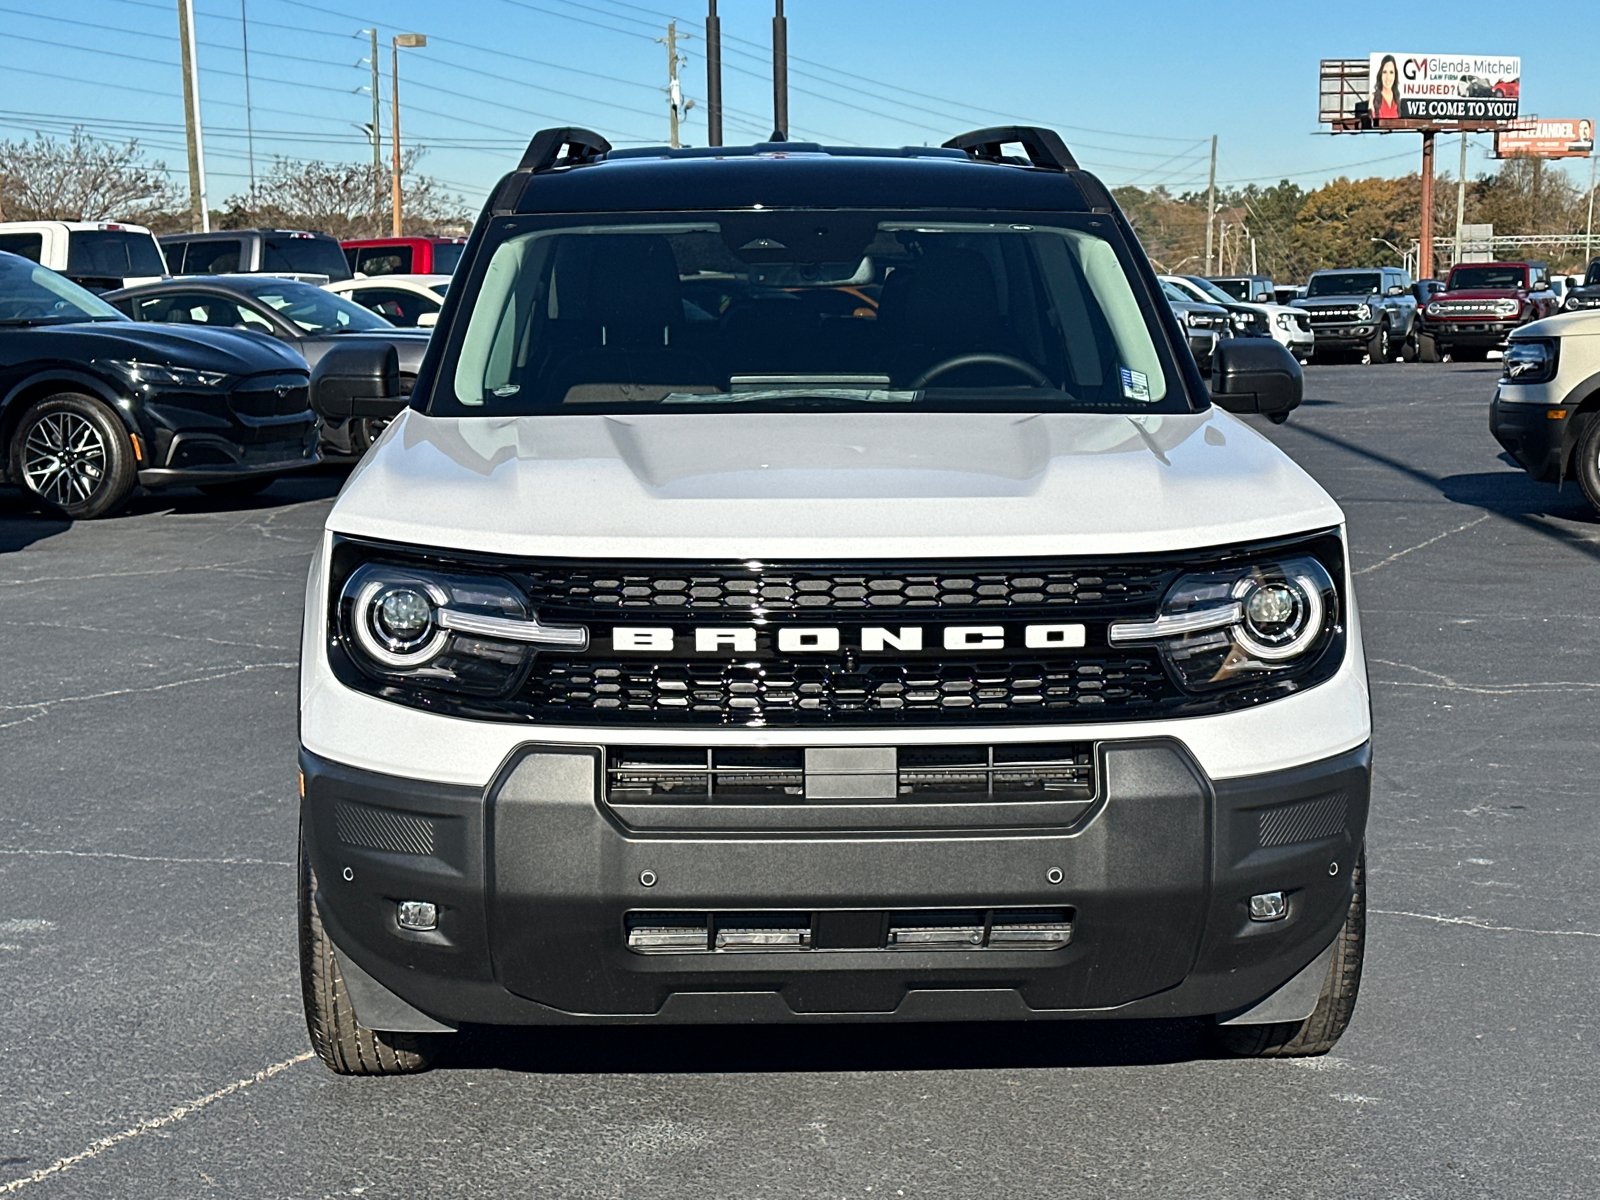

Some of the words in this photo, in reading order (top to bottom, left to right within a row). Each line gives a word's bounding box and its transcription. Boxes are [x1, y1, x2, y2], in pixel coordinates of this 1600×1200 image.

[1404, 58, 1428, 80] GM
[1429, 58, 1470, 73] Glenda
[1474, 59, 1518, 75] Mitchell
[1404, 84, 1456, 95] INJURED?
[1407, 101, 1427, 115] WE
[1428, 101, 1465, 116] COME
[1467, 102, 1486, 116] TO
[1487, 102, 1517, 117] YOU!
[613, 624, 1086, 652] BRONCO
